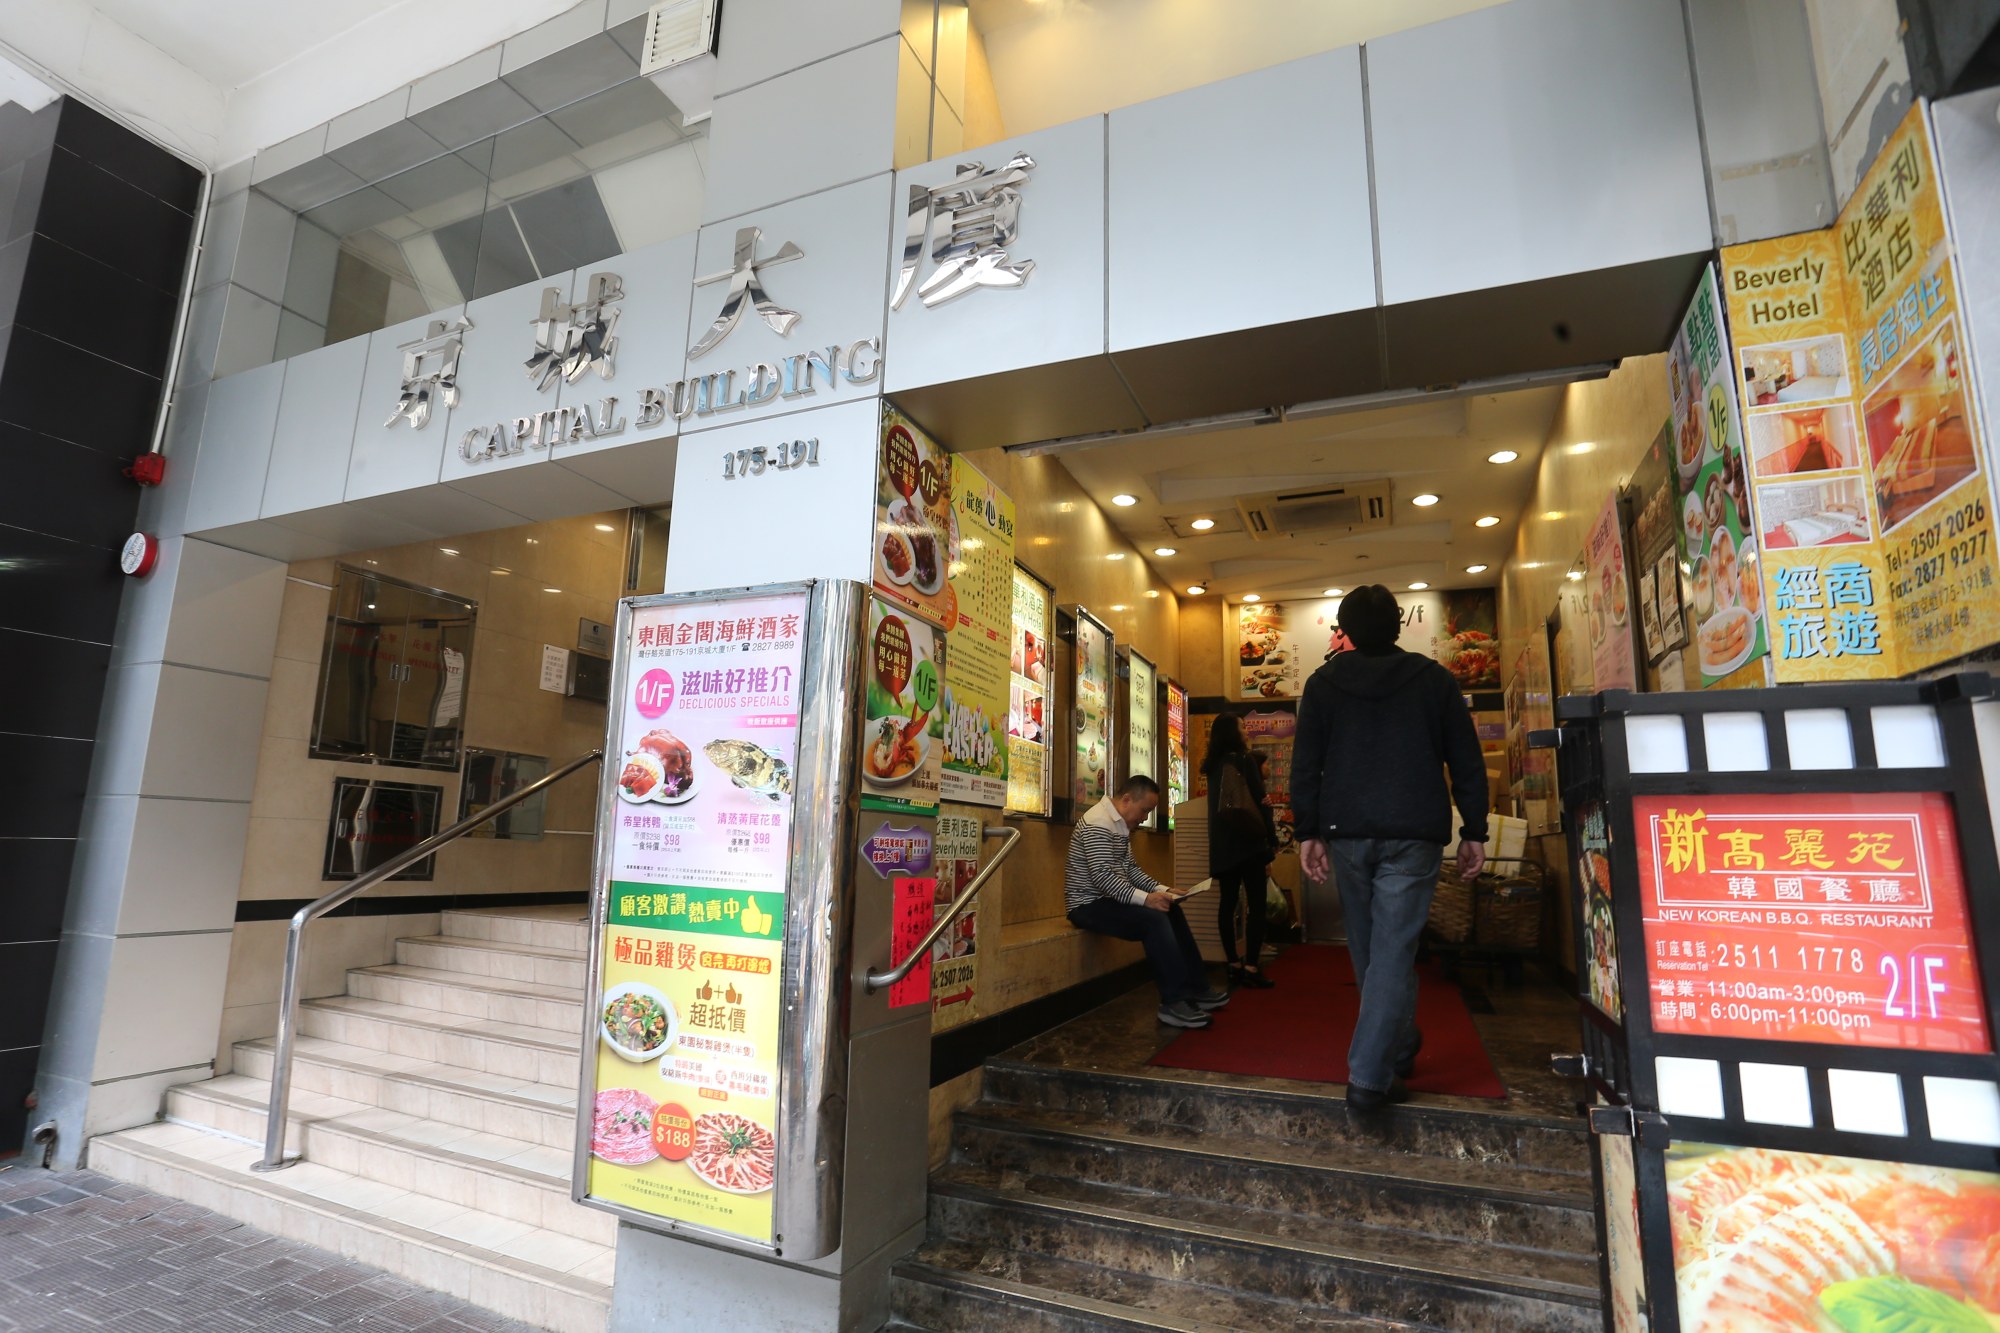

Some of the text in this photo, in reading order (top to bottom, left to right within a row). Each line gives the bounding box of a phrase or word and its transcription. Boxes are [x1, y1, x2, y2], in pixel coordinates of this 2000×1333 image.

[1843, 139, 1921, 274] 比華利
[1733, 256, 1825, 292] Beverly
[1862, 217, 1914, 311] 酒店
[384, 151, 1037, 430] 京城大廈
[1752, 293, 1820, 325] Hotel
[459, 336, 883, 466] CAPITAL BUILDING
[722, 436, 821, 479] 175-191
[920, 466, 939, 497] 1/F
[1911, 524, 1941, 561] 2507
[1946, 499, 1985, 538] 2026
[1915, 553, 1946, 589] 2877
[1951, 530, 1988, 568] 9277
[1773, 562, 1875, 610] 經商
[637, 614, 800, 648] 東園金閣海鮮酒家
[752, 642, 773, 652] 2827
[774, 640, 795, 650] 8989
[1779, 609, 1883, 660] 旅遊
[639, 679, 672, 708] 1/F
[680, 665, 792, 696] 滋味好推介
[915, 668, 937, 701] 1/F
[679, 694, 790, 710] DECLICIOUS SPECIALS
[664, 834, 680, 846] $98
[753, 832, 770, 845] $98
[936, 841, 957, 859] everly
[959, 840, 978, 856] Hotel
[1727, 876, 1903, 903] 韓國餐廳
[1659, 909, 1934, 930] NEW KOREAN B.B.Q. RESTAURANT
[614, 935, 697, 972] 極品雞煲
[1655, 940, 1708, 959] 訂座電話
[1798, 946, 1864, 974] 1778
[1657, 960, 1696, 972] Reservation
[940, 969, 957, 987] 2507
[958, 965, 974, 983] 2026
[1879, 955, 1946, 1019] 2/F
[1657, 978, 1866, 1007] 營業 11:00am-3:00pm
[689, 1002, 747, 1034] 超抵價
[1660, 1001, 1871, 1030] 時間 6:00pm-11:00pm
[656, 1126, 691, 1148] $188
